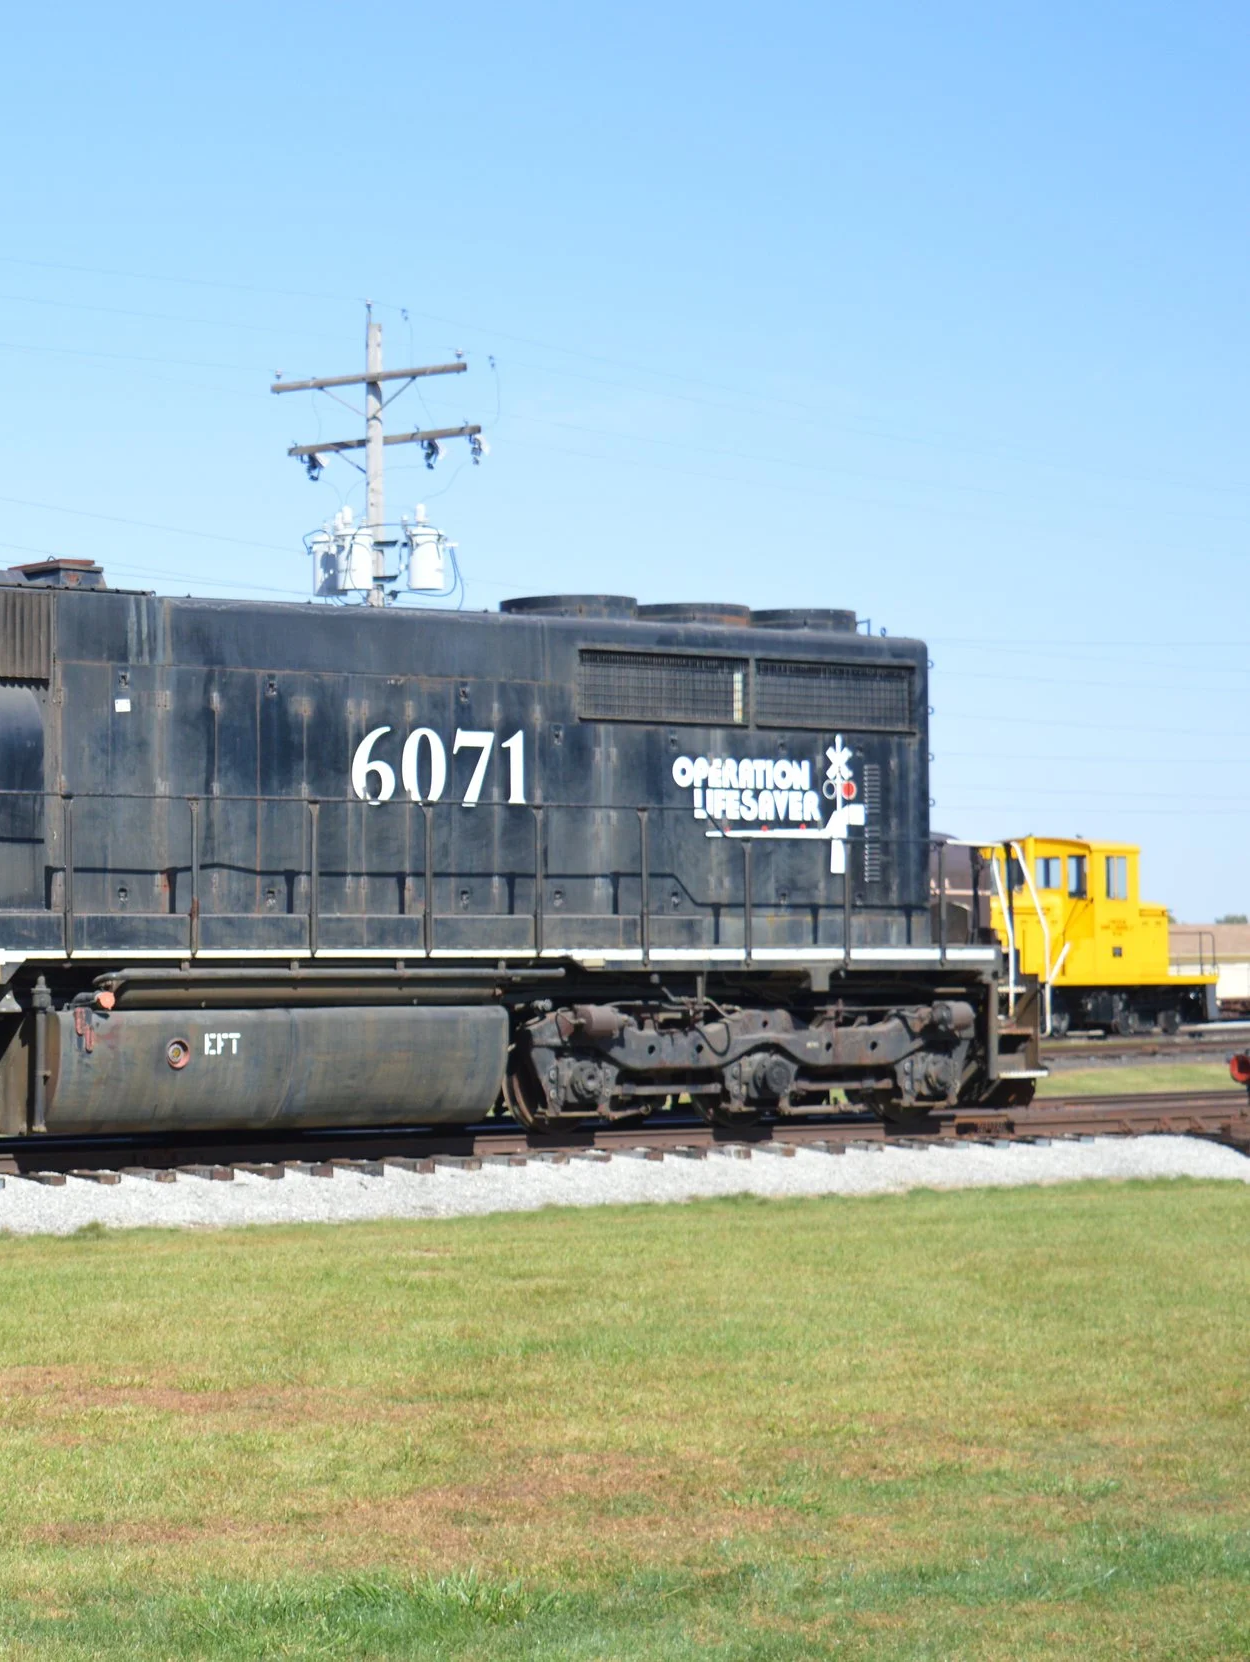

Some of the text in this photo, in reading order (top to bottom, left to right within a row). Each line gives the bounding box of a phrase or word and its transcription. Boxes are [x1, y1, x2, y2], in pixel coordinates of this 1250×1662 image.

[352, 726, 526, 807] 6071
[672, 755, 810, 791] OPERATION
[693, 788, 821, 822] LIFESAVER
[204, 1032, 241, 1055] EFT
